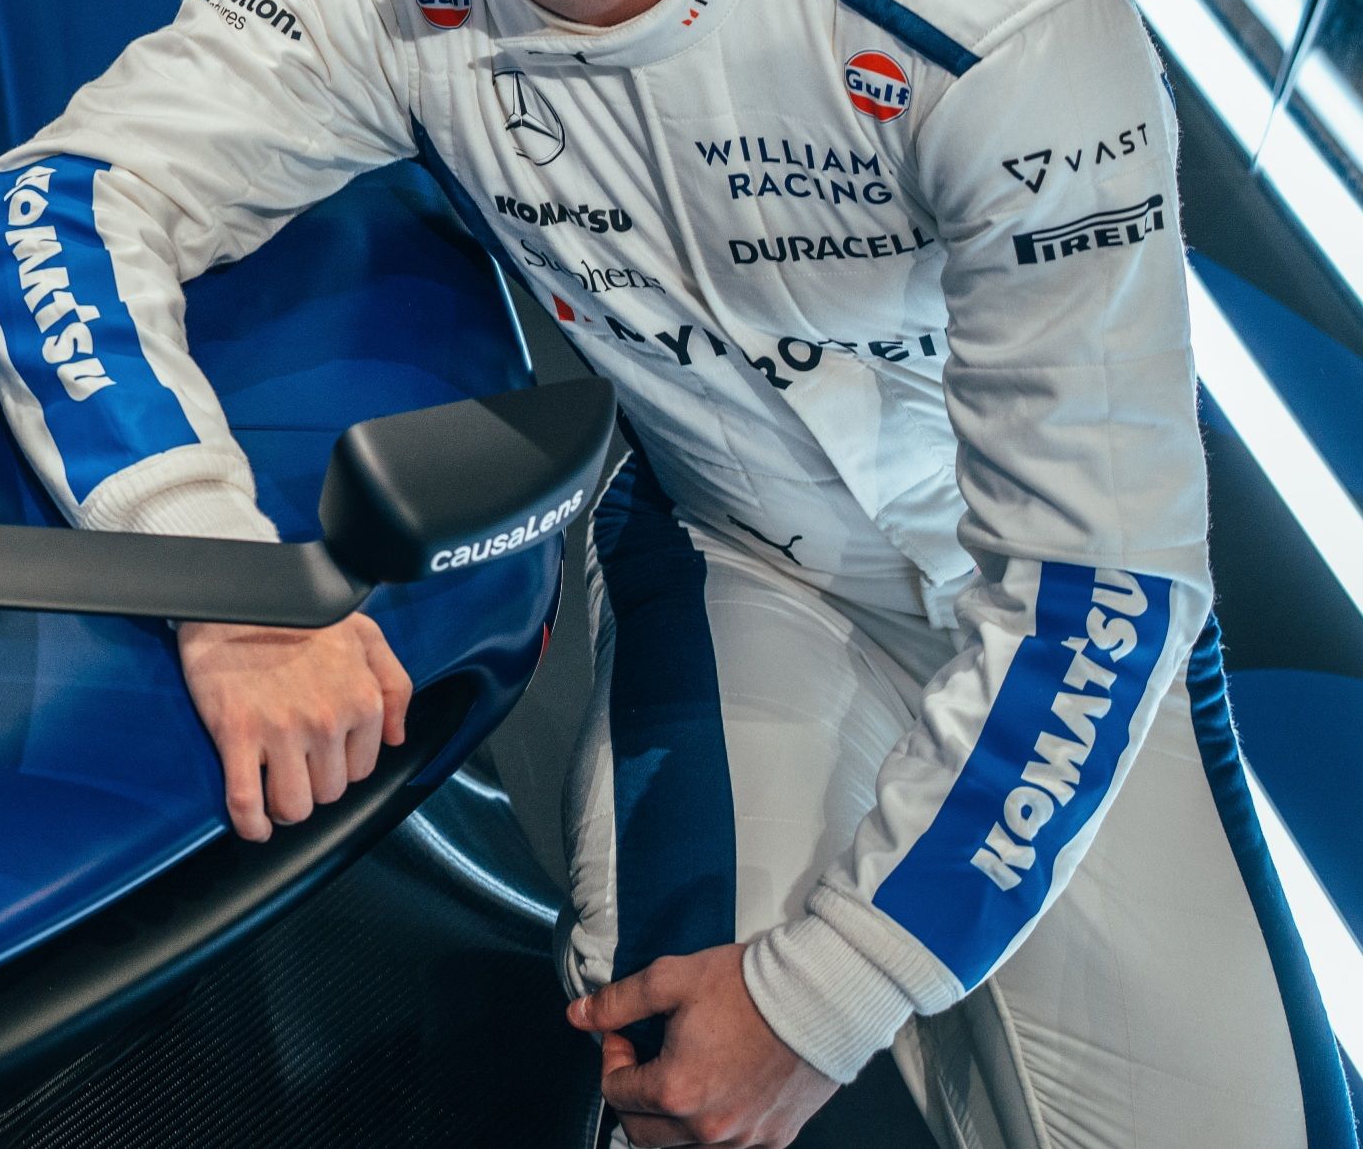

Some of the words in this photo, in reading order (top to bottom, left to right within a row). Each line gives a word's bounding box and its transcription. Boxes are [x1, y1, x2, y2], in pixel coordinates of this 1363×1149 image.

[845, 69, 910, 107] Gulf
[694, 135, 894, 178] WILLIAM
[1065, 123, 1148, 172] VAST
[728, 172, 893, 206] RACING
[729, 226, 935, 265] DURACELL
[3, 165, 117, 401] KOMATSU
[430, 488, 584, 572] causaLens
[969, 568, 1149, 892] KOMATSU
